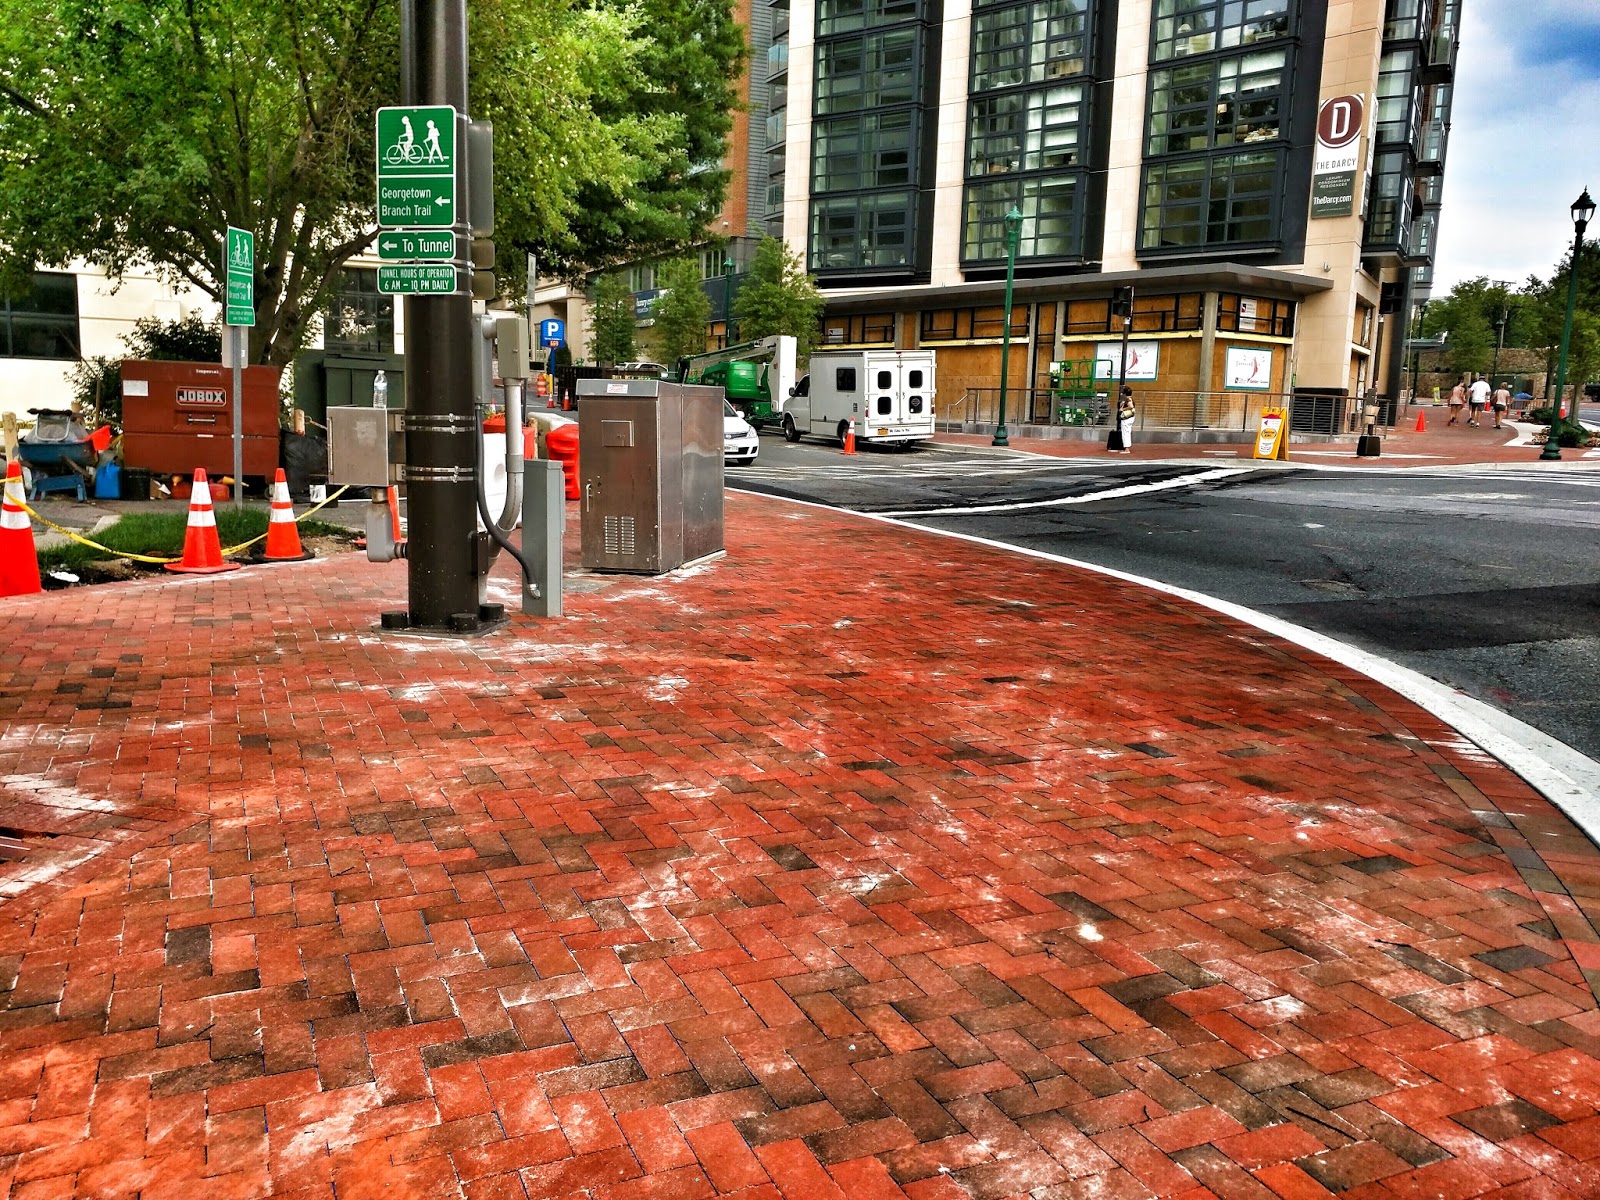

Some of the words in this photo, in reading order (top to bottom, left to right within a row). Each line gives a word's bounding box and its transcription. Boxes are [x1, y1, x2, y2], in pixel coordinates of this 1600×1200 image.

[1330, 101, 1351, 139] D
[1316, 161, 1330, 170] THE
[1331, 158, 1357, 169] DARCY
[381, 187, 431, 202] Georgetown
[1313, 195, 1352, 205] TheDarcy.com
[381, 205, 411, 216] Branch
[414, 205, 431, 216] Trail
[402, 239, 414, 253] To
[418, 238, 452, 253] Tunnel
[380, 269, 398, 278] TUNNEL
[400, 269, 417, 278] HOURS
[419, 269, 425, 278] OF
[427, 268, 453, 278] OPERATION
[384, 281, 389, 290] 6
[391, 280, 400, 290] AM
[411, 280, 418, 290] 10
[420, 280, 430, 290] PM
[432, 280, 449, 290] DAILY
[547, 321, 559, 337] P
[178, 390, 224, 403] JOBOX
